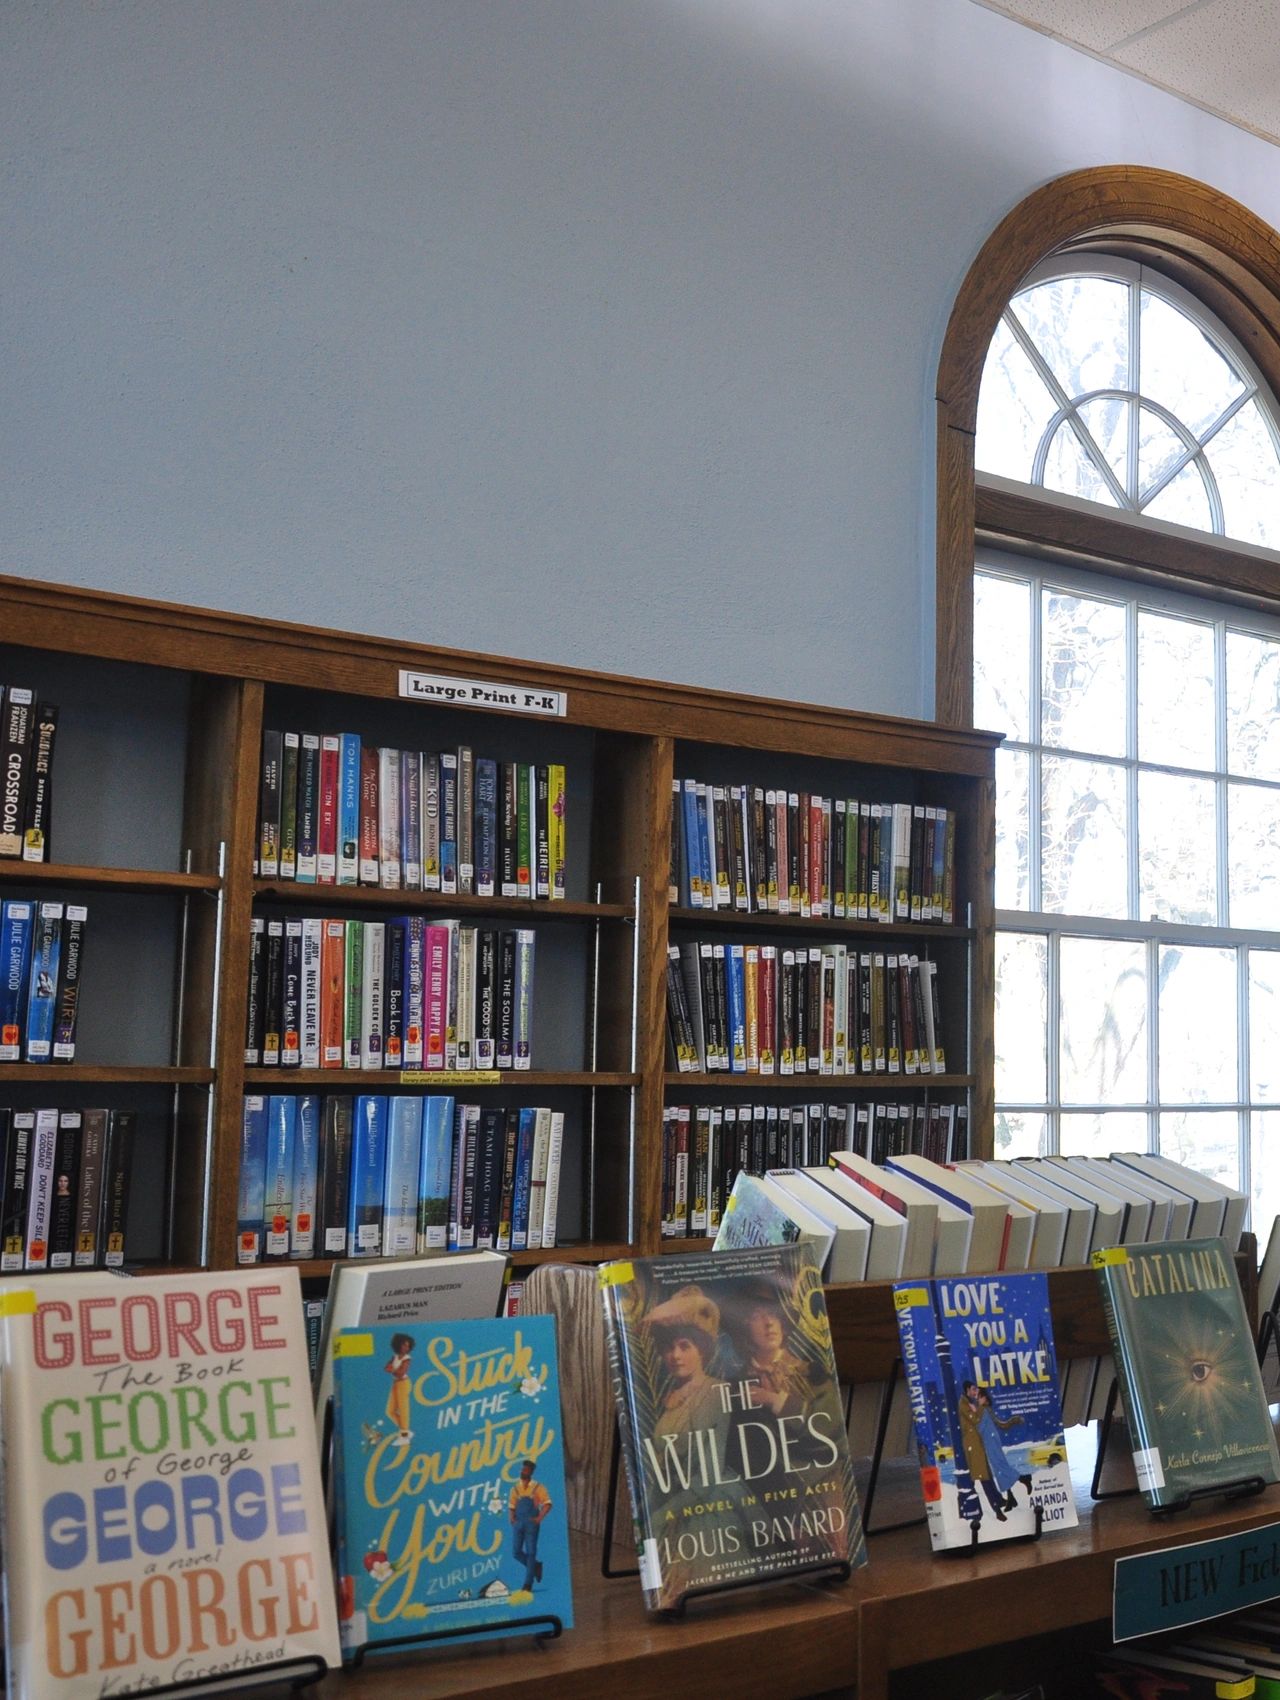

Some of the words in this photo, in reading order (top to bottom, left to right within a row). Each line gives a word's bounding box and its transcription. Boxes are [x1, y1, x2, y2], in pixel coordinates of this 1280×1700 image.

[413, 681, 467, 699] Large
[471, 688, 517, 704] Print
[524, 694, 554, 709] F-K
[9, 706, 20, 743] FRANZEN
[18, 707, 27, 745] JONATHAN
[347, 743, 355, 765] TOM
[37, 779, 45, 802] DAVID
[427, 788, 437, 818] KID
[445, 779, 455, 815] CHARLAINE
[445, 816, 454, 840] HARRIS
[11, 922, 23, 944] JULIE
[70, 921, 80, 940] JULIE
[66, 943, 79, 980] GARWOOD
[311, 942, 319, 959] JODY
[433, 946, 442, 967] EMILY
[8, 947, 22, 990] GARWOOD
[432, 970, 442, 995] HENRY
[307, 970, 316, 999] NEVER
[503, 979, 511, 997] THE
[306, 1001, 316, 1029] LEAVE
[391, 990, 401, 1017] Book
[431, 1002, 441, 1028] HAPPY
[306, 1033, 315, 1047] ME
[17, 1131, 28, 1154] ALWAYS
[37, 1134, 46, 1169] GODDARD
[45, 1131, 55, 1170] ELIZABETH
[466, 1136, 475, 1177] HILLERMAN
[16, 1155, 26, 1171] LOOK
[484, 1161, 492, 1192] HOAG
[14, 1172, 25, 1190] TWICE
[37, 1175, 47, 1199] DON'T
[83, 1167, 95, 1197] Ladies
[35, 1201, 45, 1223] KEEP
[390, 1286, 411, 1296] LARGE
[412, 1284, 433, 1294] PRINT
[434, 1282, 463, 1292] EDITION
[1126, 1250, 1231, 1298] CATALINA
[379, 1302, 411, 1312] LAZARUS
[412, 1300, 428, 1308] MAN
[941, 1282, 1004, 1317] LOVE
[32, 1286, 287, 1370] GEORGE
[964, 1320, 1006, 1348] YOU
[1014, 1318, 1029, 1344] A
[904, 1332, 916, 1359] YOU
[94, 1364, 162, 1392] The
[175, 1359, 244, 1384] Book
[414, 1330, 548, 1407] Stuck
[908, 1362, 919, 1373] A
[973, 1350, 1050, 1388] LATKE
[437, 1405, 462, 1430] IN
[466, 1391, 510, 1420] THE
[711, 1378, 763, 1414] THE
[909, 1375, 926, 1424] LATKE
[41, 1376, 296, 1466] GEORGE
[104, 1457, 140, 1483] of
[157, 1448, 253, 1476] George
[364, 1413, 554, 1508] Country
[643, 1412, 839, 1494] WILDES
[1165, 1453, 1190, 1471] Karla
[1192, 1450, 1222, 1465] Cornejo
[428, 1478, 502, 1517] WITH
[665, 1509, 675, 1521] A
[683, 1500, 733, 1517] NOVEL
[741, 1495, 756, 1506] IN
[764, 1488, 798, 1503] FIVE
[805, 1481, 837, 1496] ACTS
[1029, 1491, 1068, 1509] AMANDA
[42, 1463, 308, 1571] GEORGE
[664, 1525, 740, 1565] LOUIS
[752, 1506, 845, 1548] BAYARD
[144, 1563, 156, 1575] a
[168, 1549, 222, 1571] novel
[369, 1504, 503, 1624] You
[426, 1570, 468, 1595] ZURI
[472, 1554, 503, 1579] DAY
[685, 1575, 713, 1588] JACKIE
[725, 1571, 736, 1579] ME
[739, 1567, 756, 1578] AND
[759, 1564, 774, 1572] THE
[777, 1558, 797, 1569] PALE
[800, 1554, 819, 1565] BLUE
[711, 1556, 762, 1572] BESTSELLING
[765, 1549, 798, 1562] AUTHOR
[1160, 1555, 1224, 1607] NEW
[45, 1552, 320, 1680] GEORGE
[101, 1675, 160, 1697] Kate
[172, 1640, 287, 1683] Greathead
